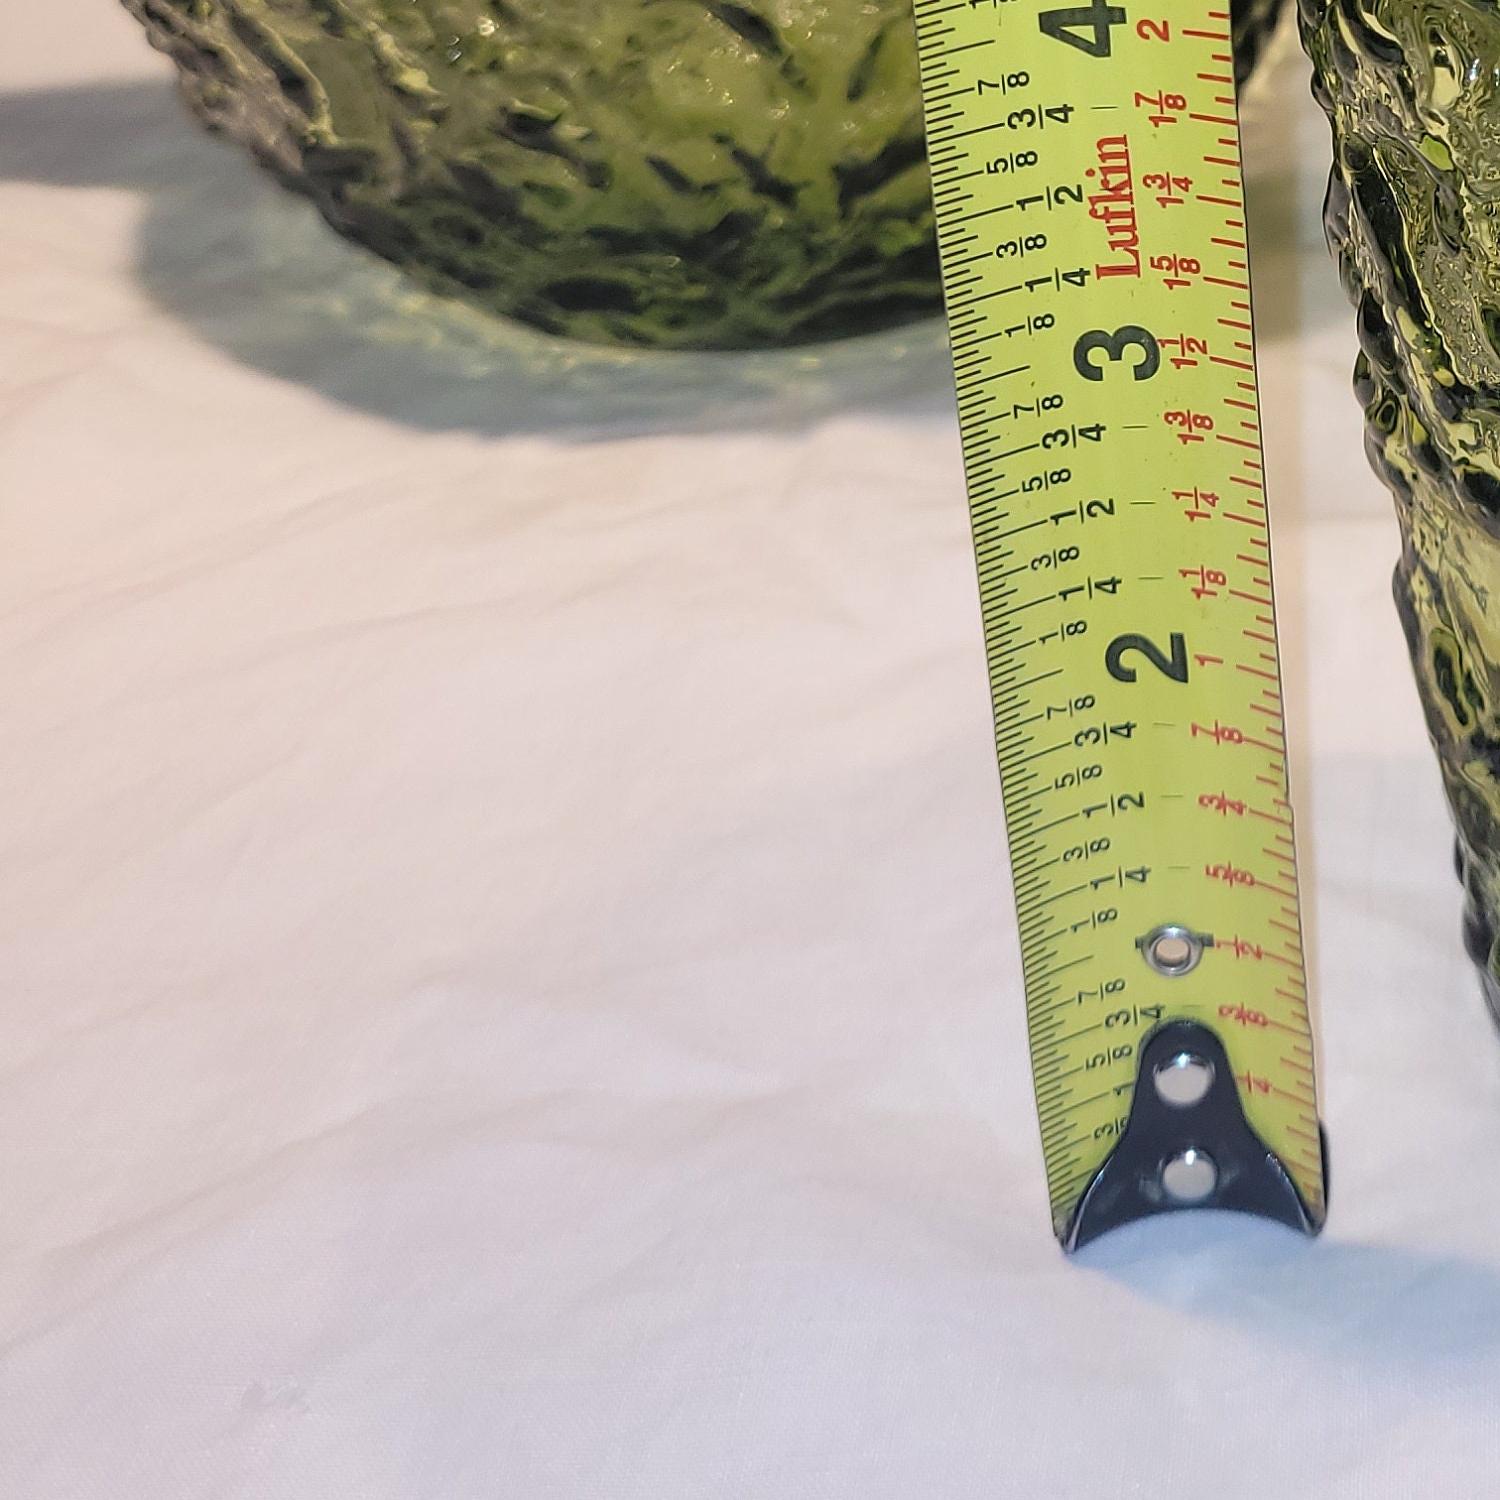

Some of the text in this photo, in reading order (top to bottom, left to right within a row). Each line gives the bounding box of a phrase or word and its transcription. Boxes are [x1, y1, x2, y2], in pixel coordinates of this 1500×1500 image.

[1136, 18, 1171, 42] 2
[1085, 134, 1142, 280] Lufkin
[1073, 325, 1161, 382] 3
[1104, 632, 1189, 684] 2
[1194, 653, 1224, 667] 1
